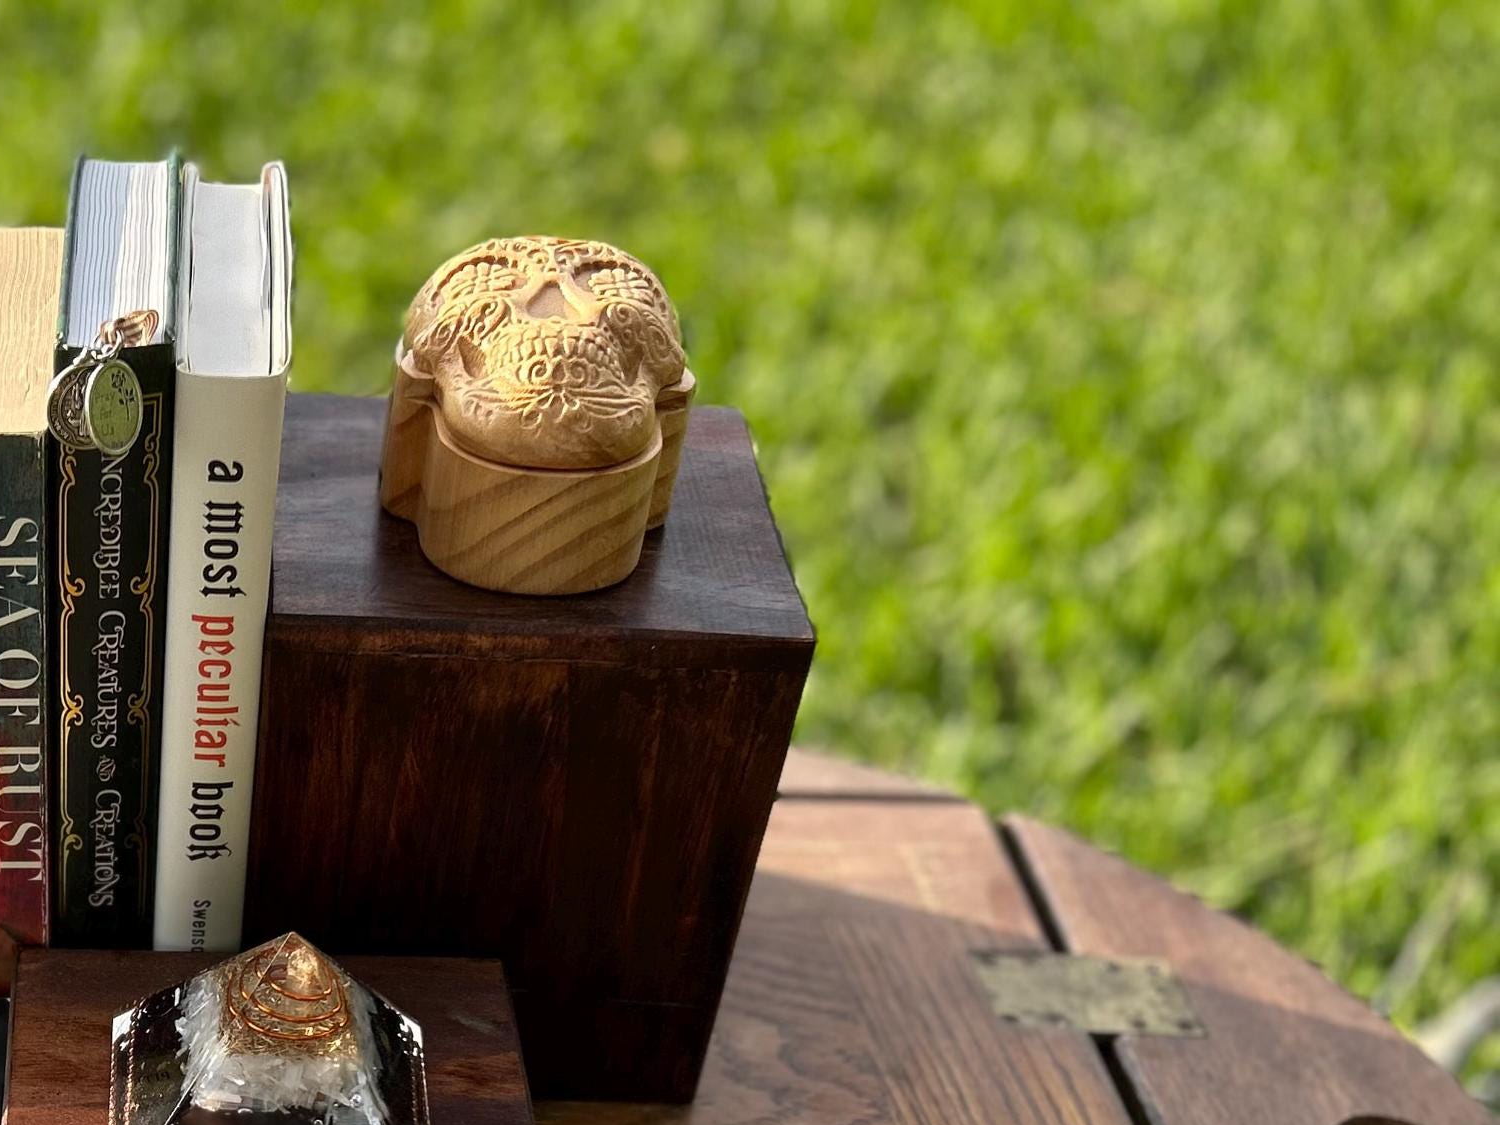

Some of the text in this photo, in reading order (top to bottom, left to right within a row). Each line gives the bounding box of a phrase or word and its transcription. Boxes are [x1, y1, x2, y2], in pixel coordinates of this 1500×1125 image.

[93, 450, 130, 600] NCREDIBLE
[90, 609, 126, 749] CREATURES
[186, 460, 247, 862] a most peculiar book
[95, 755, 117, 783] AND
[88, 788, 123, 908] CREATIONS
[191, 899, 211, 951] Swenso
